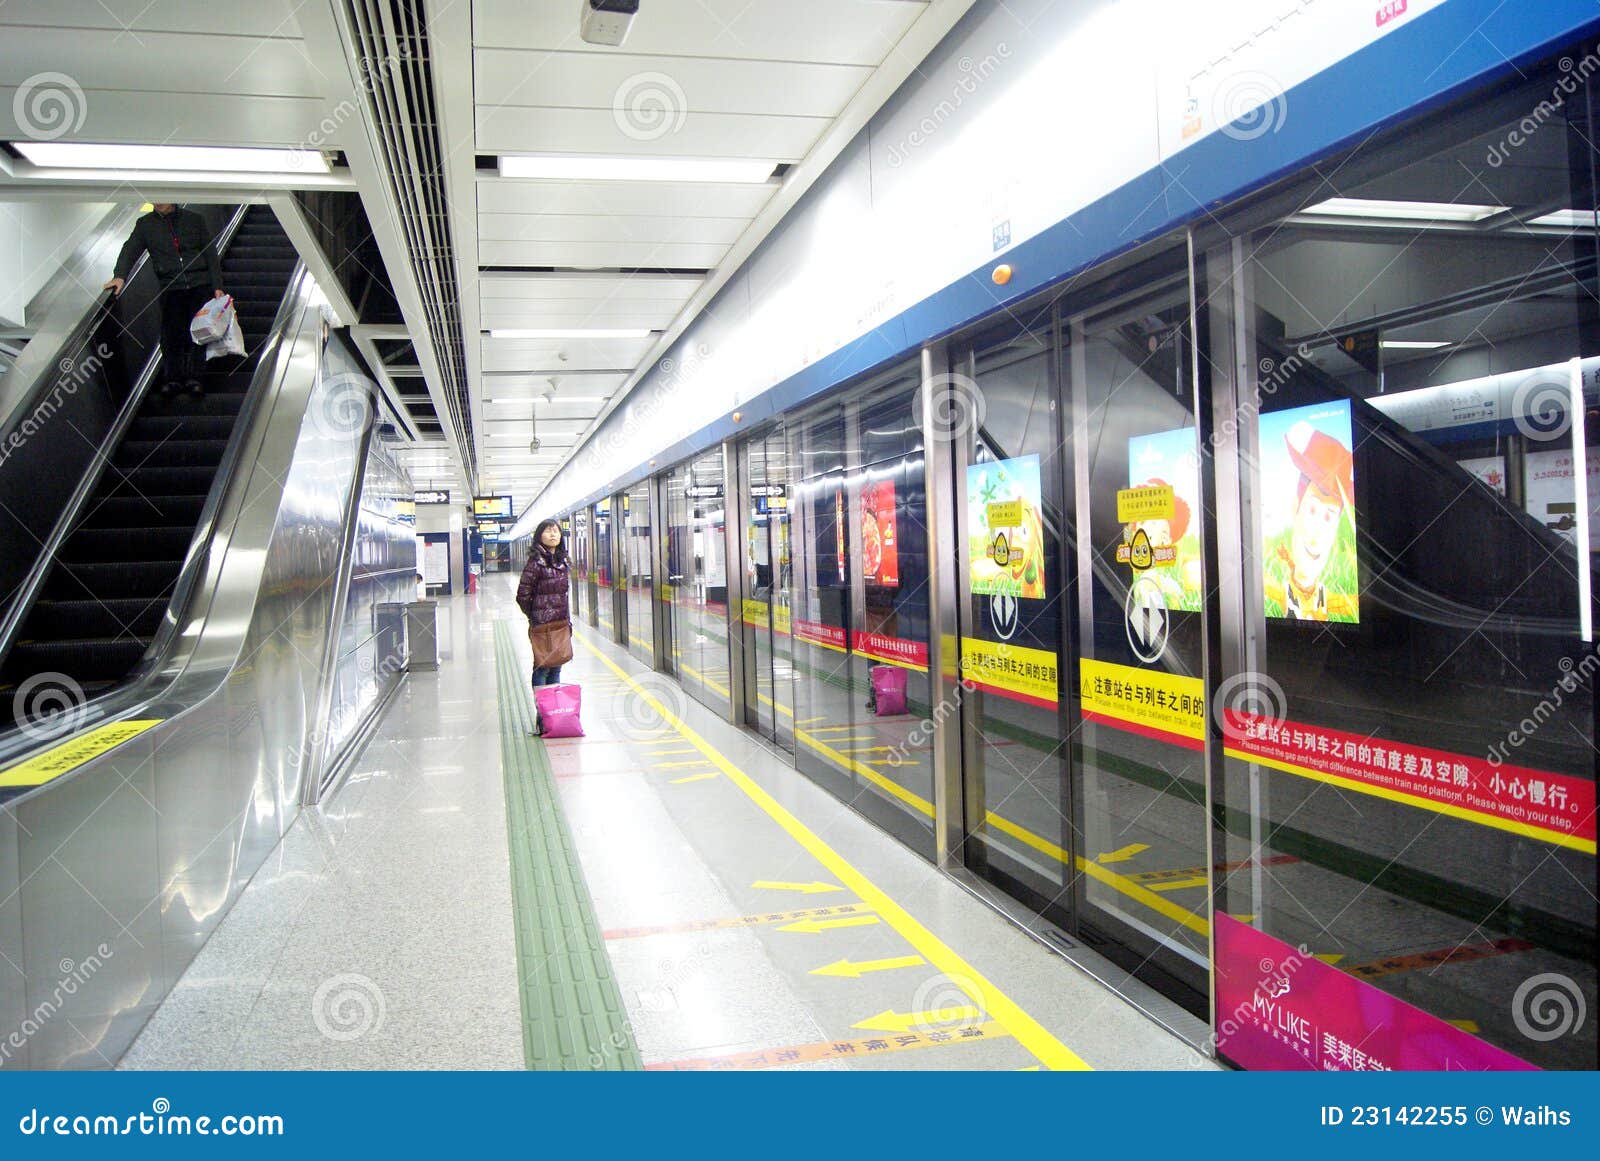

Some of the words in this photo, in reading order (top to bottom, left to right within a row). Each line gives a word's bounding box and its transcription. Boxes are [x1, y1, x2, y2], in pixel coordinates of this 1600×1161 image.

[1094, 675, 1204, 717] 注意站台与列车之间的
[1261, 745, 1274, 755] mind
[1285, 752, 1296, 763] gap
[1309, 756, 1329, 770] height
[1329, 762, 1363, 778] difference
[1363, 769, 1394, 785] between
[1394, 776, 1412, 790] train
[1413, 782, 1428, 793] and
[1429, 785, 1464, 802] platform.
[1466, 793, 1497, 811] Please
[1499, 801, 1526, 818] watch
[1526, 809, 1549, 824] your
[1550, 815, 1576, 831] step.
[1253, 991, 1275, 1021] MY
[1278, 1005, 1311, 1044] LIKE
[1323, 1031, 1393, 1071] 美莱医学
